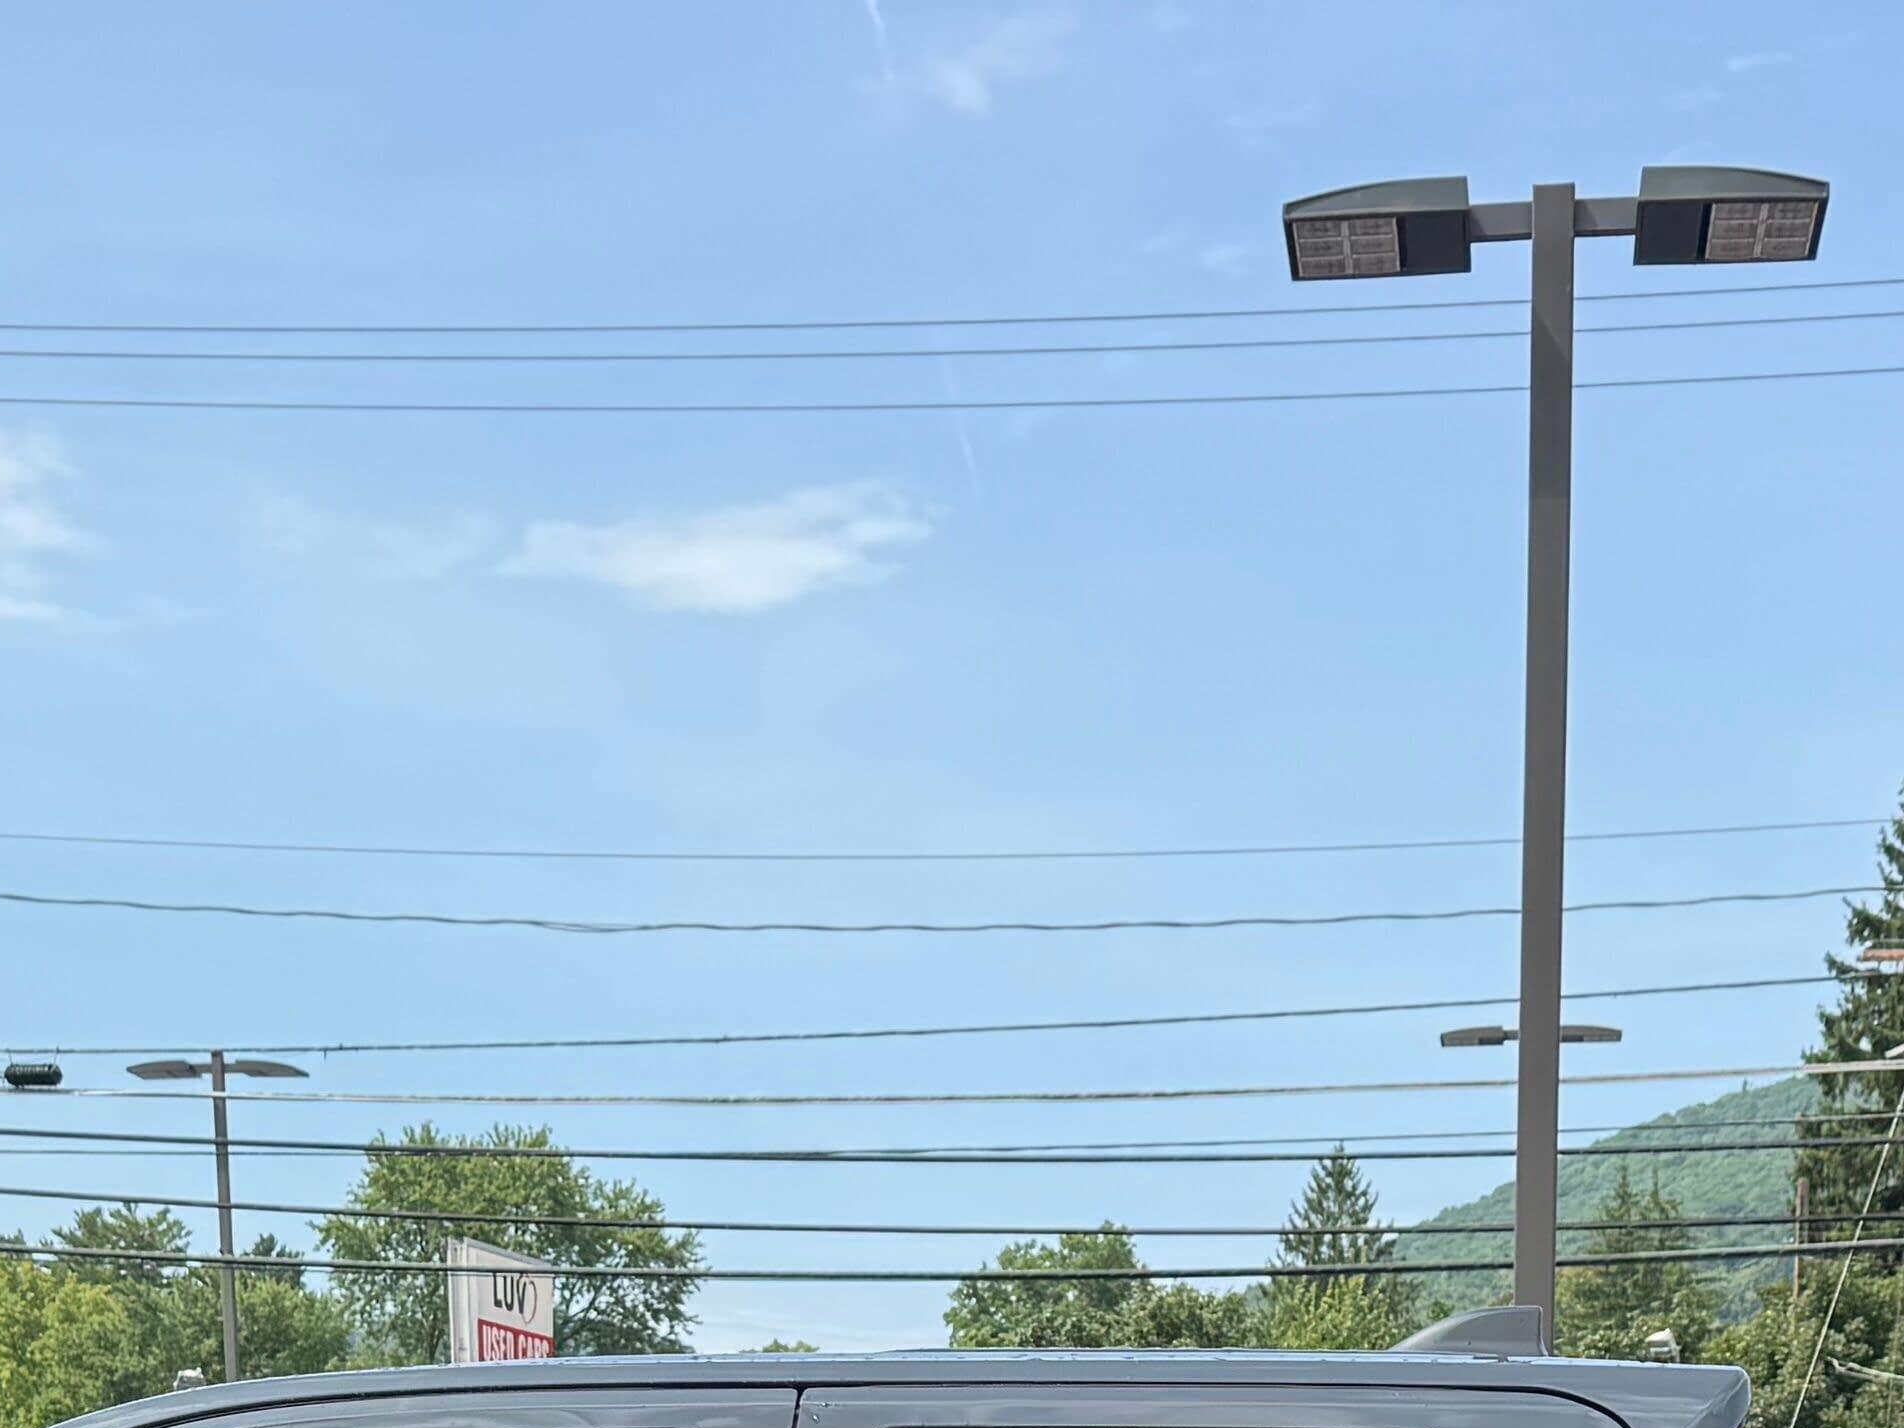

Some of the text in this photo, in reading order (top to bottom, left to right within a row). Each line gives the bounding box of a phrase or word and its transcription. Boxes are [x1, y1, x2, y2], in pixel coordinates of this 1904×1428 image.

[493, 1271, 527, 1316] LUV
[482, 1324, 551, 1361] USED CARS
